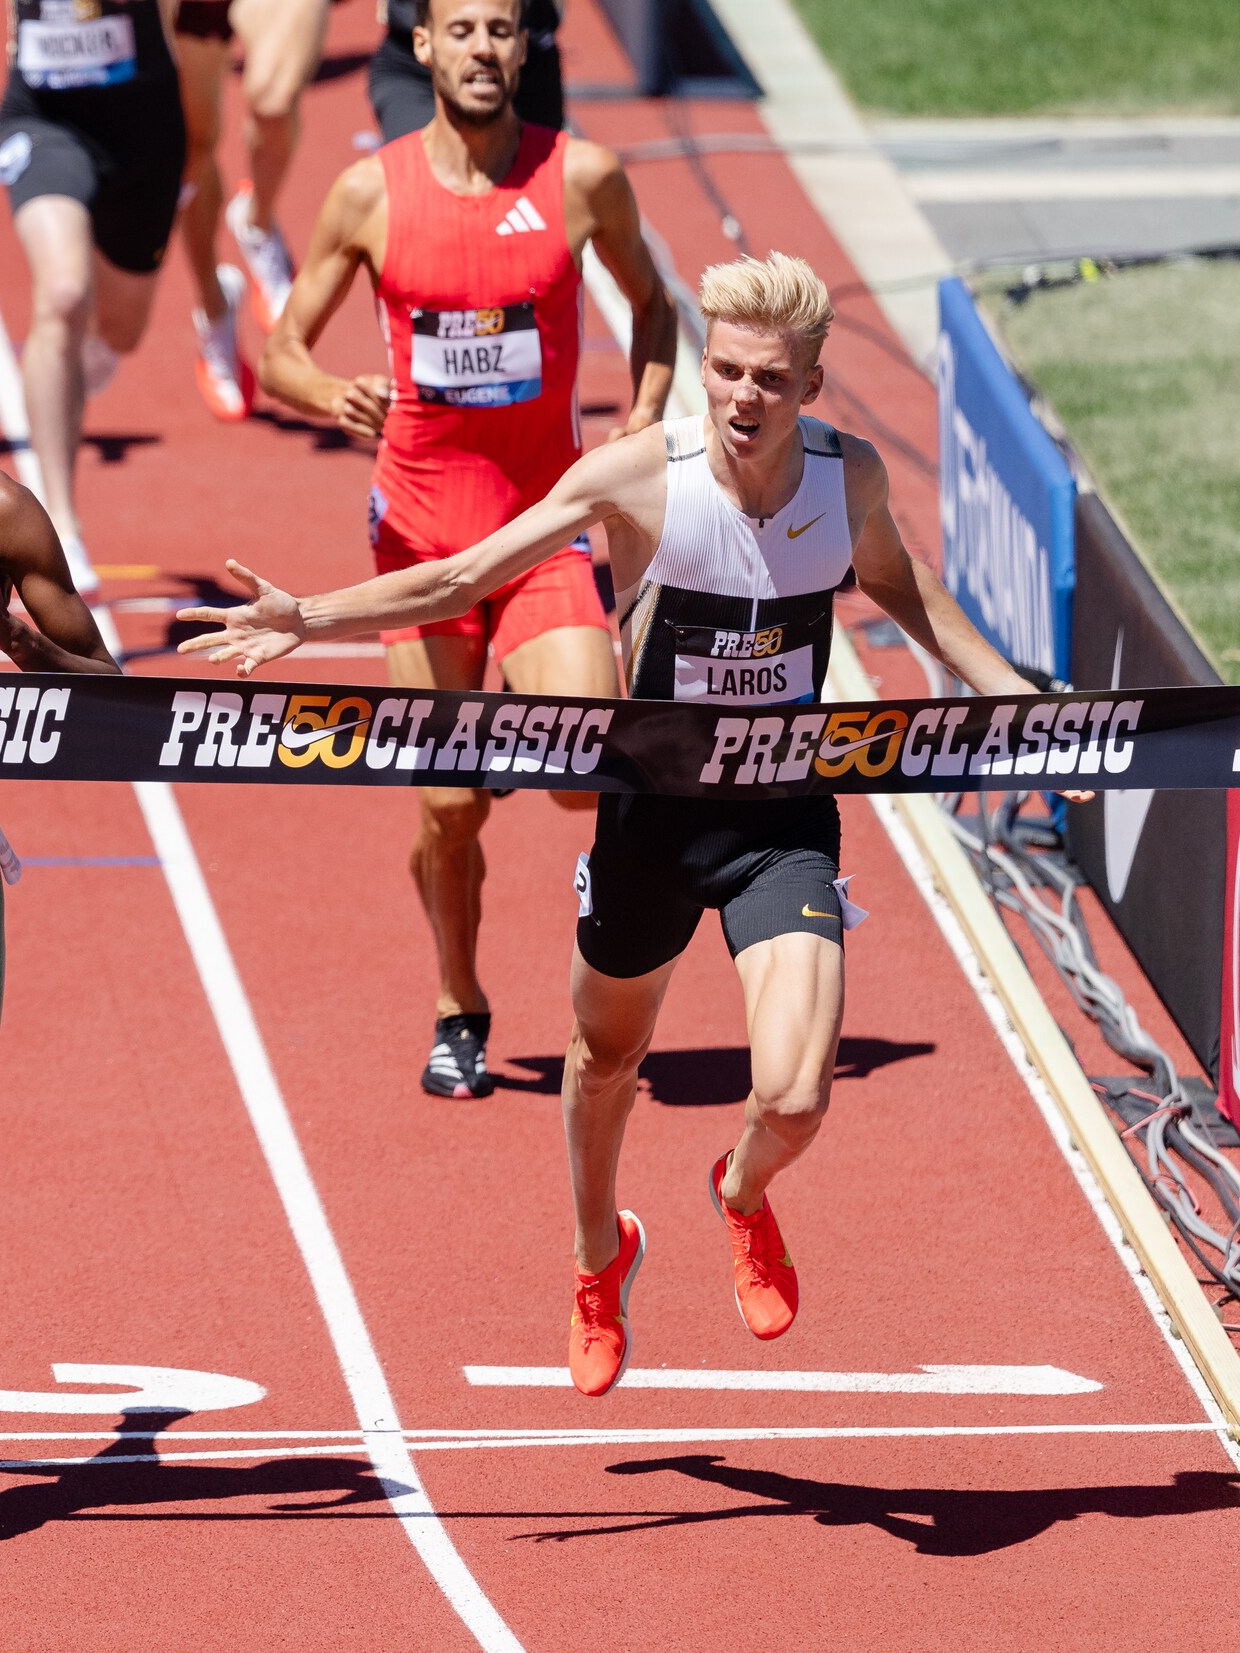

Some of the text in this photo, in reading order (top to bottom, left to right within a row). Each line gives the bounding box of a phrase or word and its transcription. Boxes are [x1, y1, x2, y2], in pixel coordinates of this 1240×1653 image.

[444, 344, 506, 376] HABZ
[706, 662, 788, 696] LAROS
[462, 1364, 1104, 1396] 1
